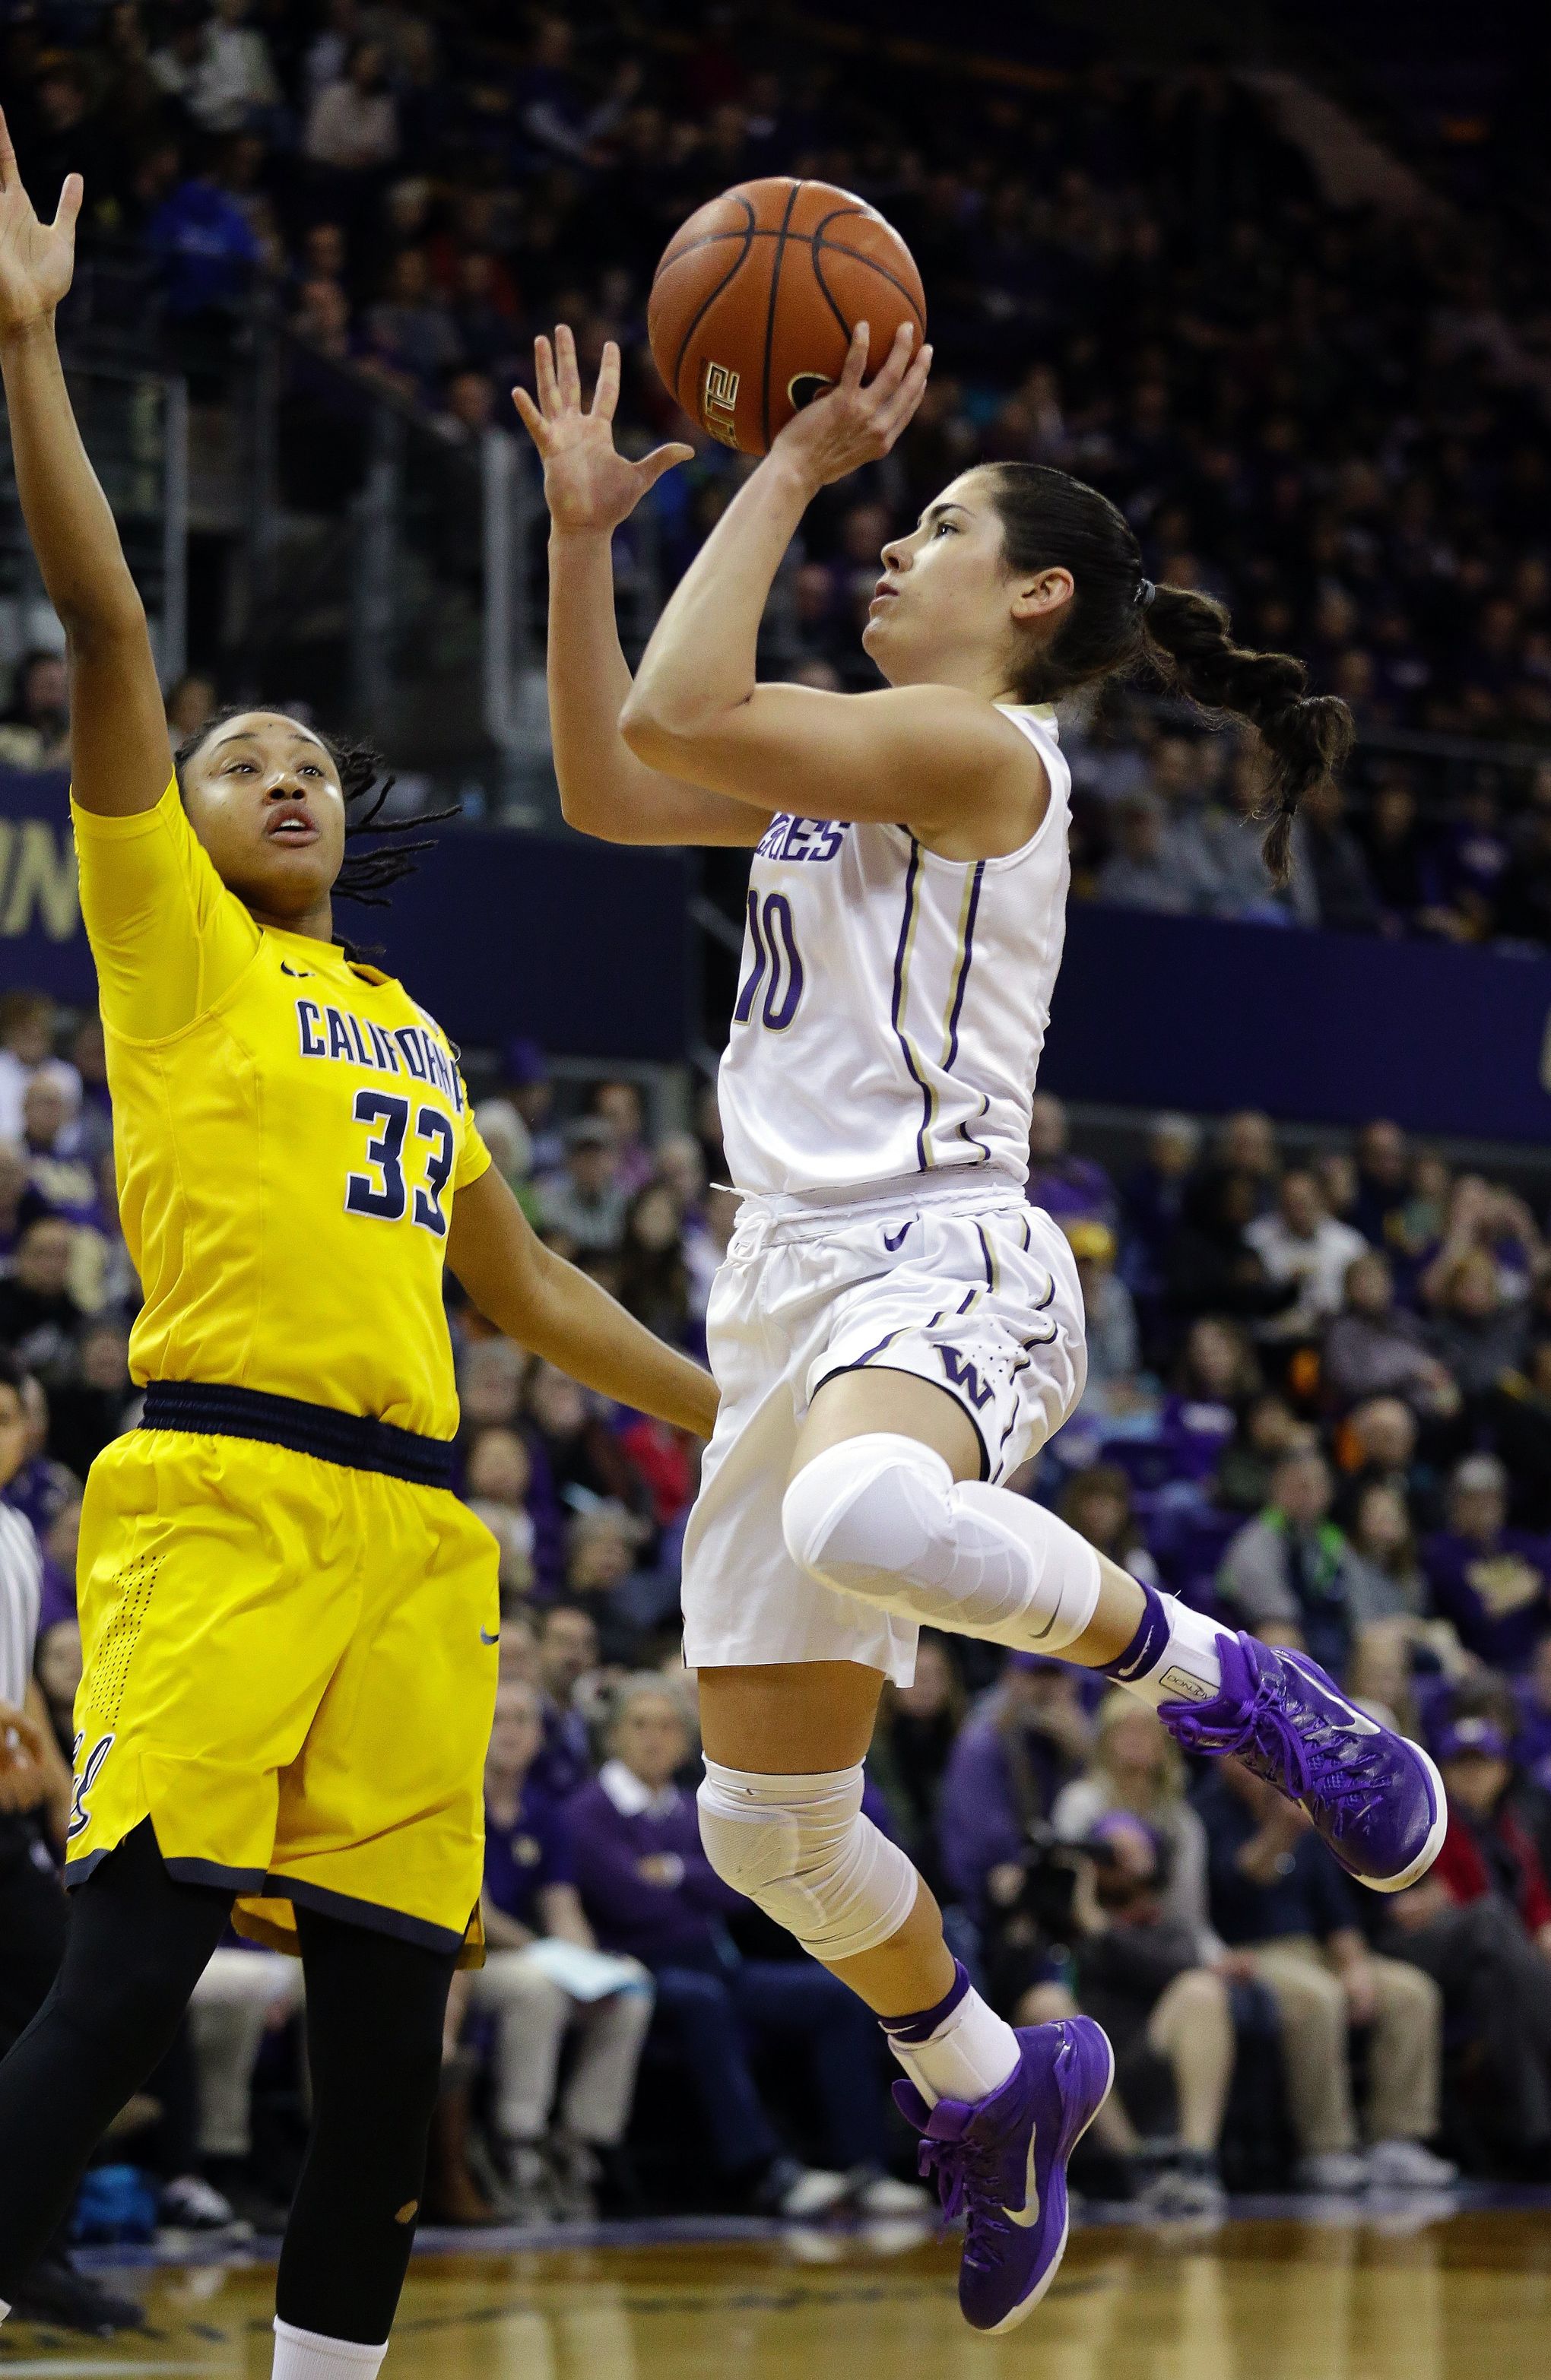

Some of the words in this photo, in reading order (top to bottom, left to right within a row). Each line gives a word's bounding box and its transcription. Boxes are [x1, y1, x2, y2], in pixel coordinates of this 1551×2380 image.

[734, 888, 806, 1034] 10
[344, 1087, 454, 1239] 33
[930, 1343, 996, 1412] W
